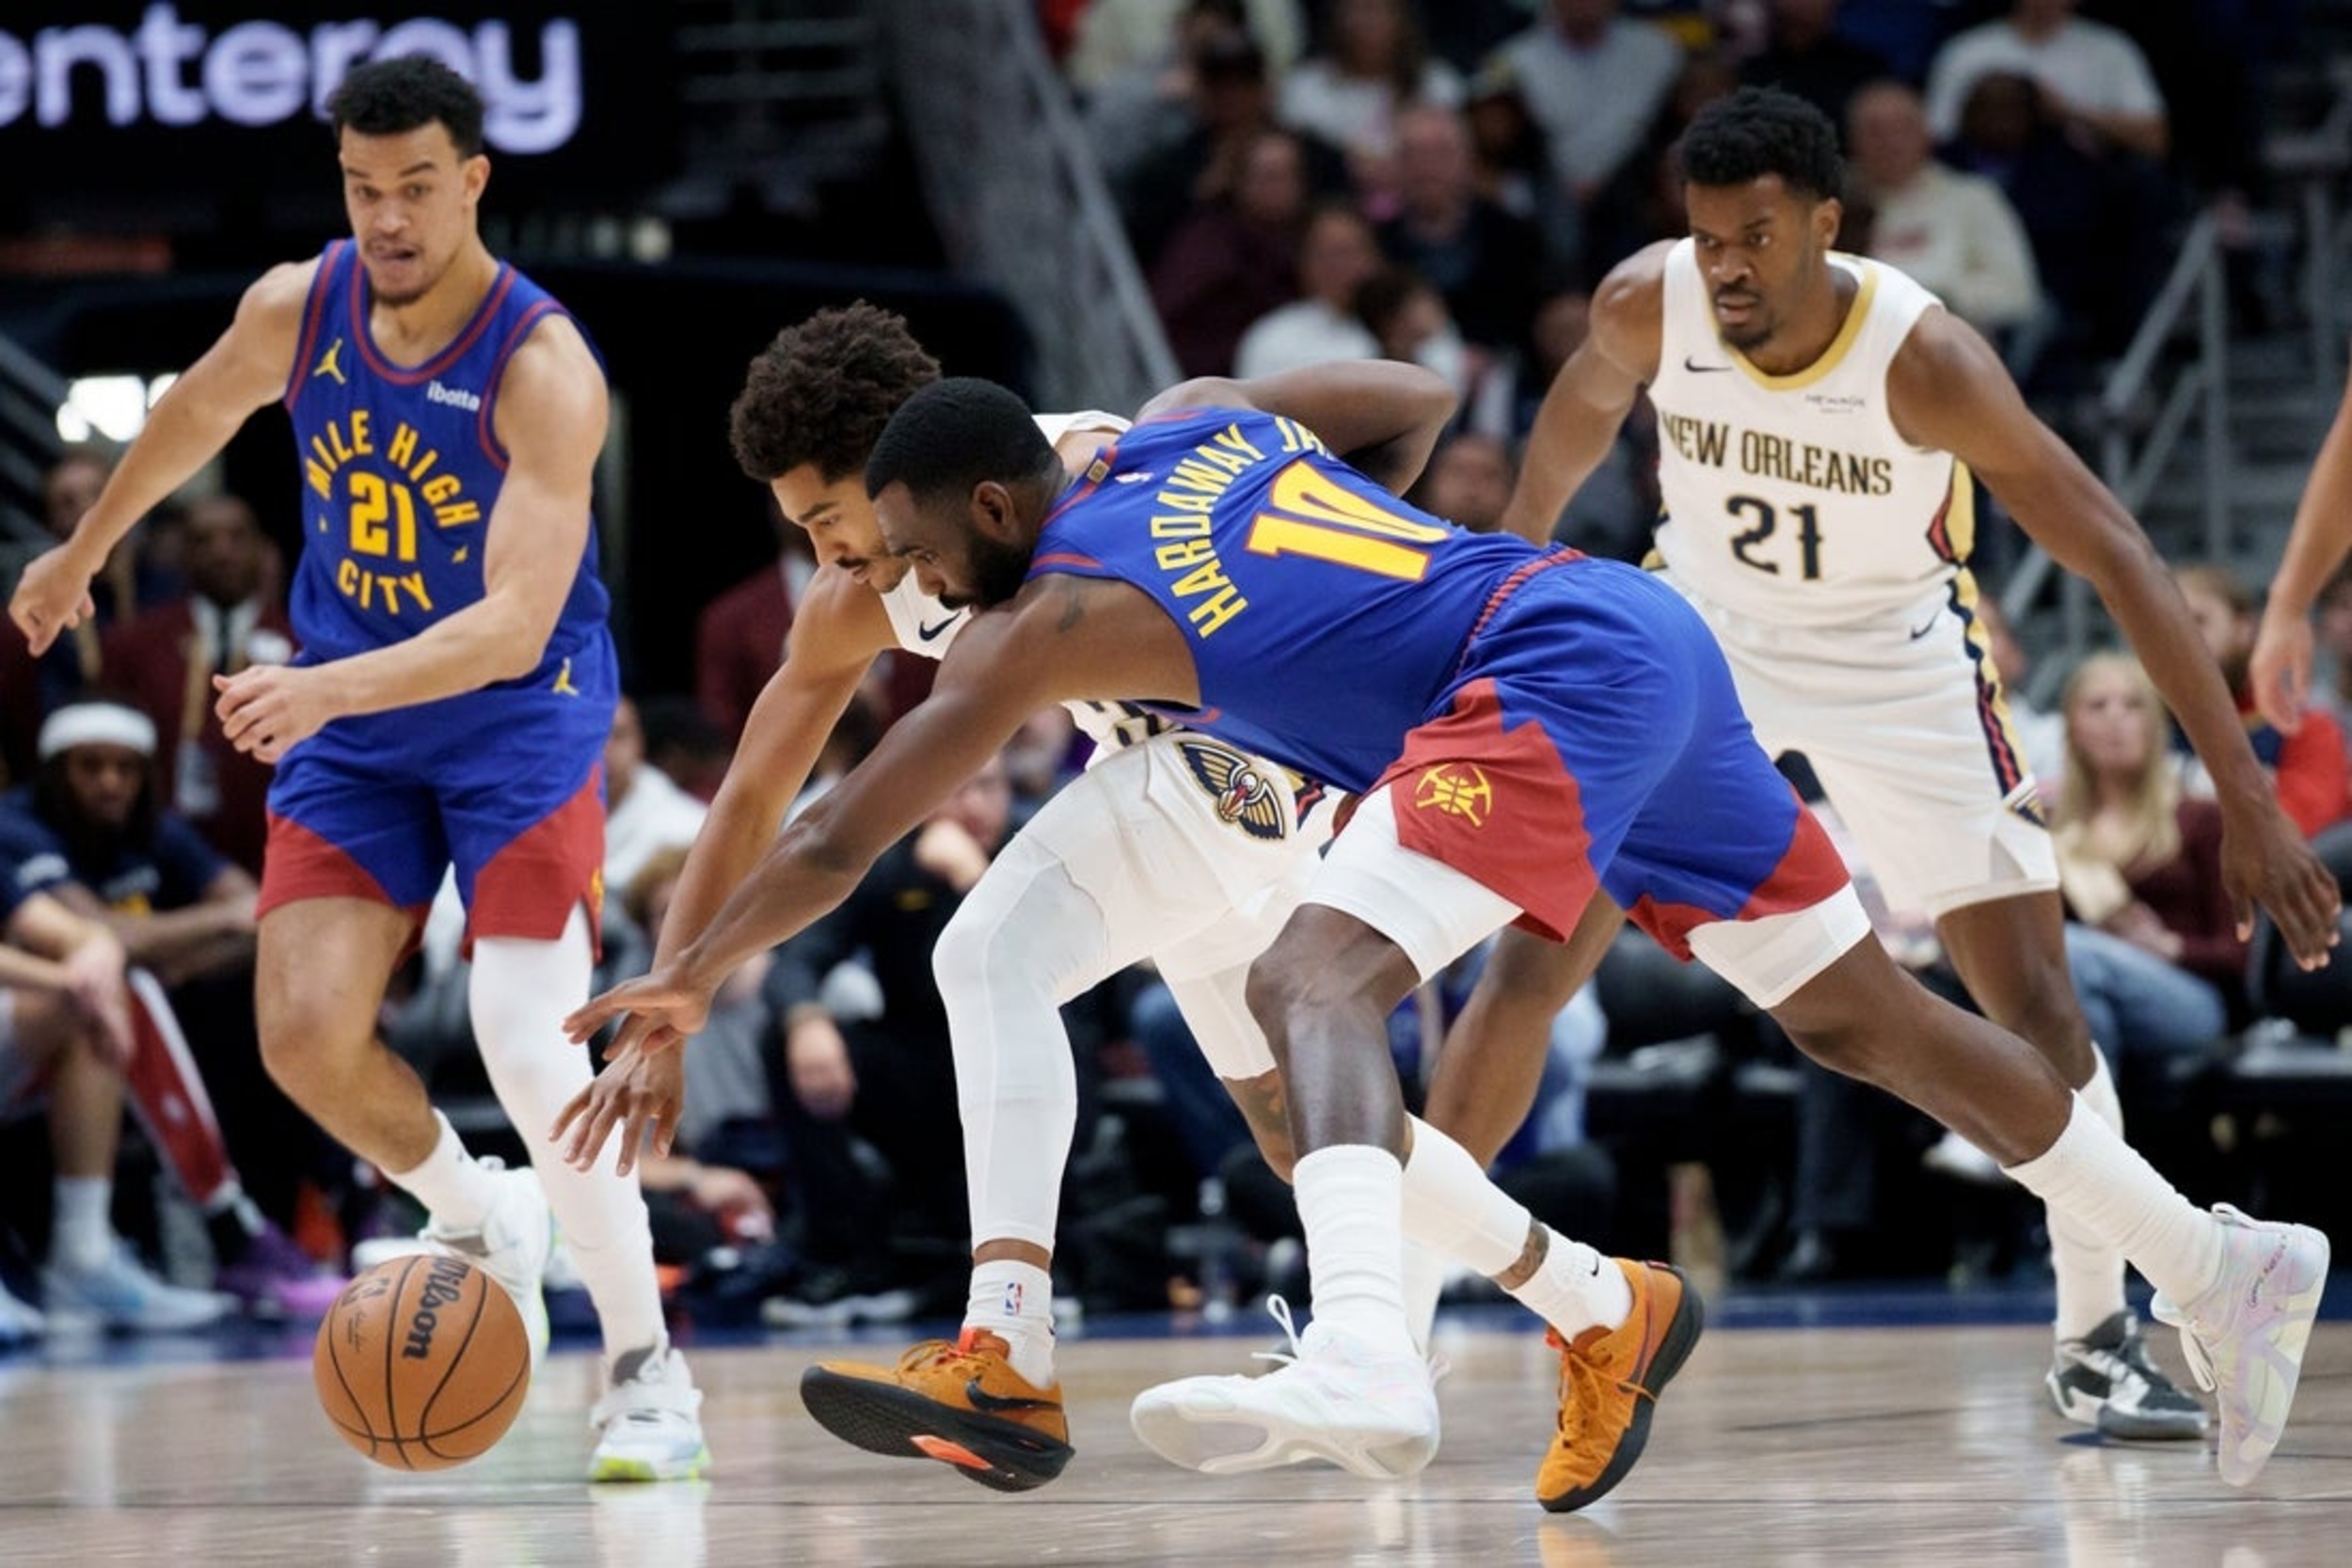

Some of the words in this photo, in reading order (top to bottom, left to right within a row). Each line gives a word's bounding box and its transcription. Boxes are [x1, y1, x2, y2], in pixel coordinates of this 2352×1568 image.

[0, 2, 581, 153] ntery
[427, 380, 481, 411] ibotta
[305, 409, 373, 501] MILE
[387, 422, 481, 527] HIGH
[1740, 429, 1892, 497] ORLEANS
[348, 470, 418, 562] 21
[1151, 423, 1266, 639] HARDAWAY
[1245, 458, 1452, 582] 10
[1724, 494, 1823, 581] 21
[337, 558, 433, 614] CITY
[402, 1256, 472, 1359] Wilson
